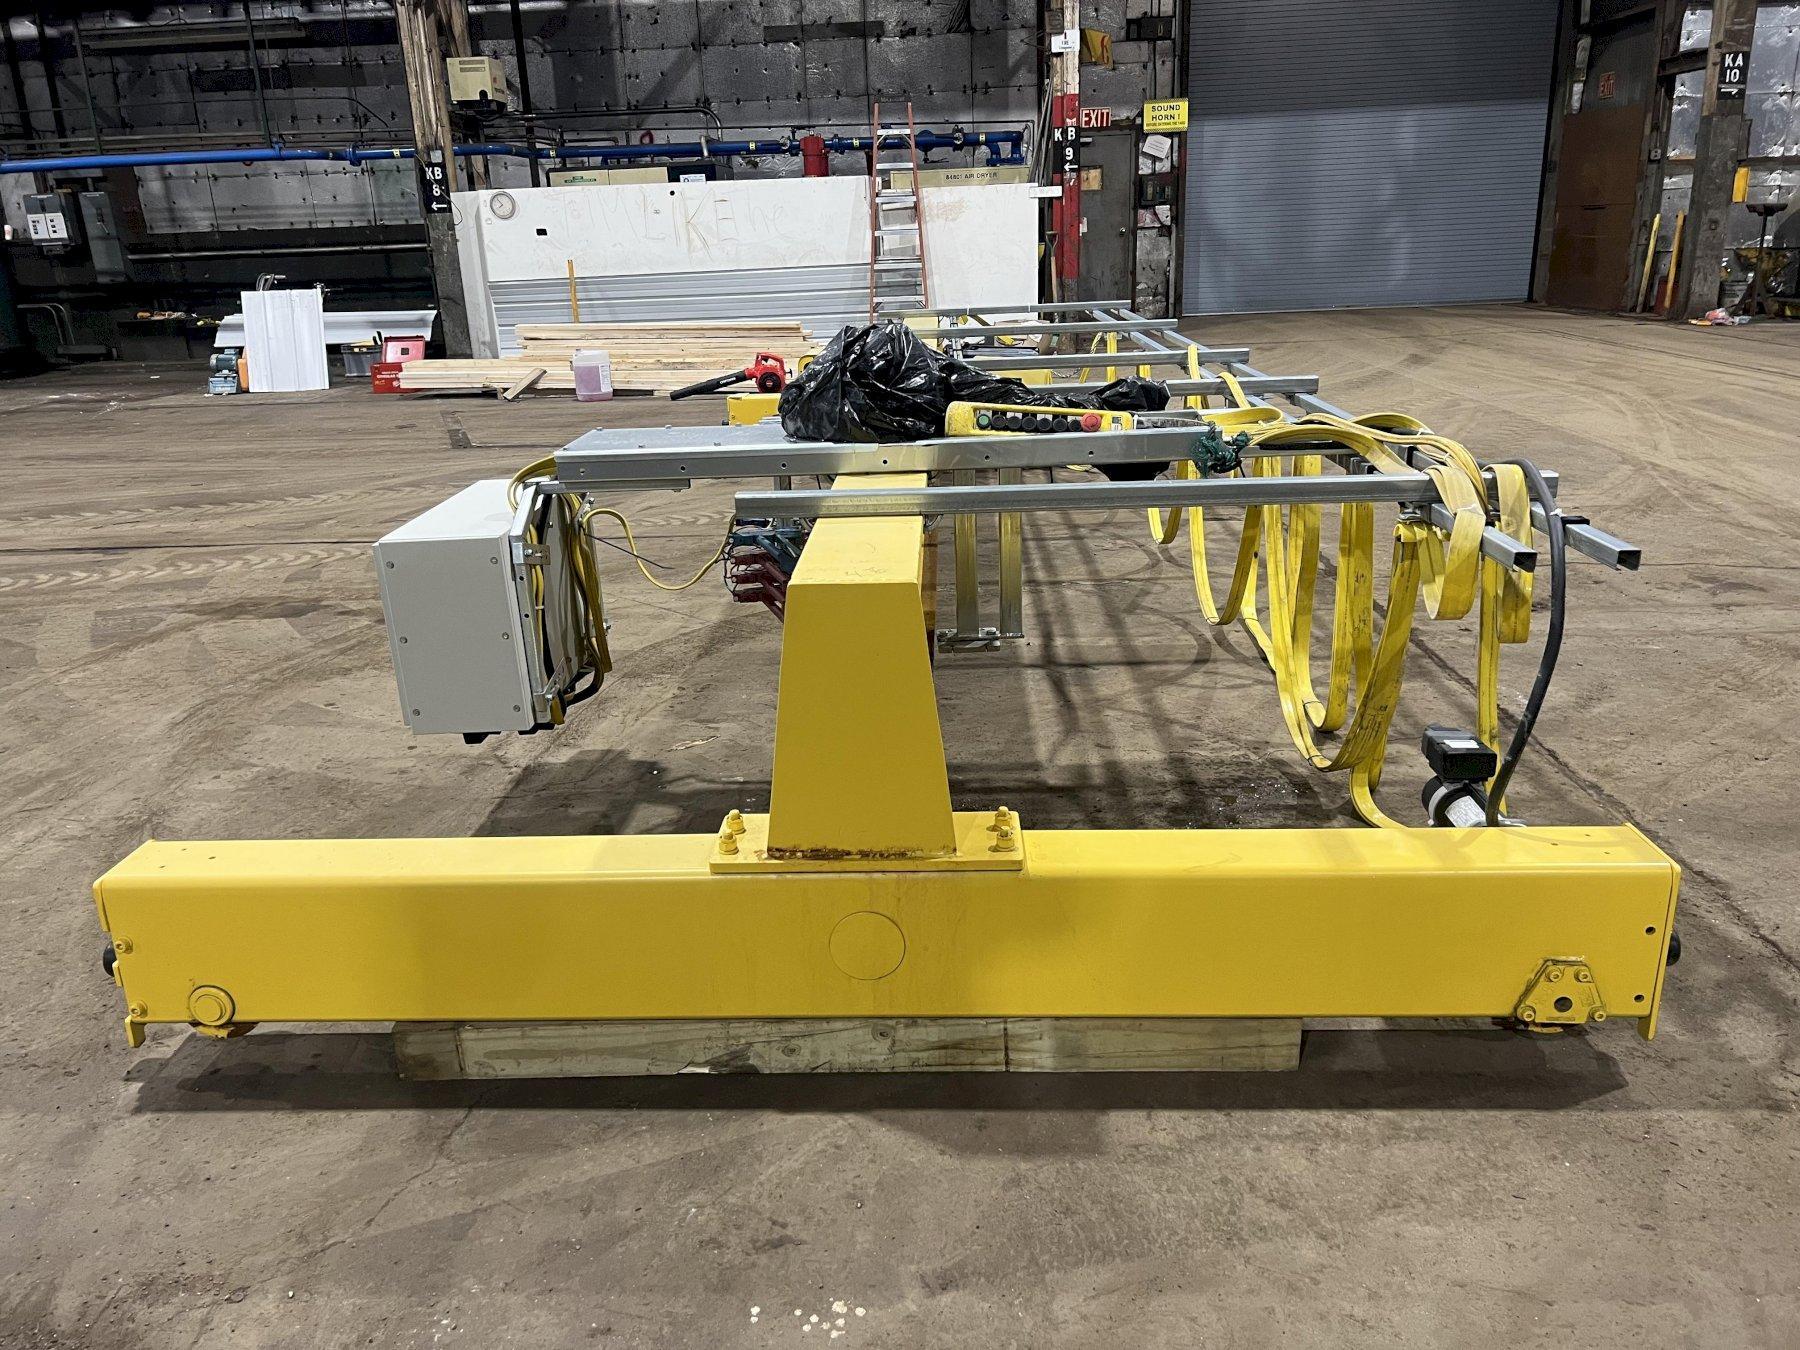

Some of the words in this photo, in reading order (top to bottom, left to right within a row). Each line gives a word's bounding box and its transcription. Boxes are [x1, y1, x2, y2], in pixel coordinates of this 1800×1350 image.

[1725, 53, 1743, 67] KA
[1726, 69, 1740, 82] 10
[1082, 109, 1109, 127] EXIT
[1065, 147, 1073, 160] 9
[425, 167, 442, 179] KB
[432, 184, 441, 196] 8
